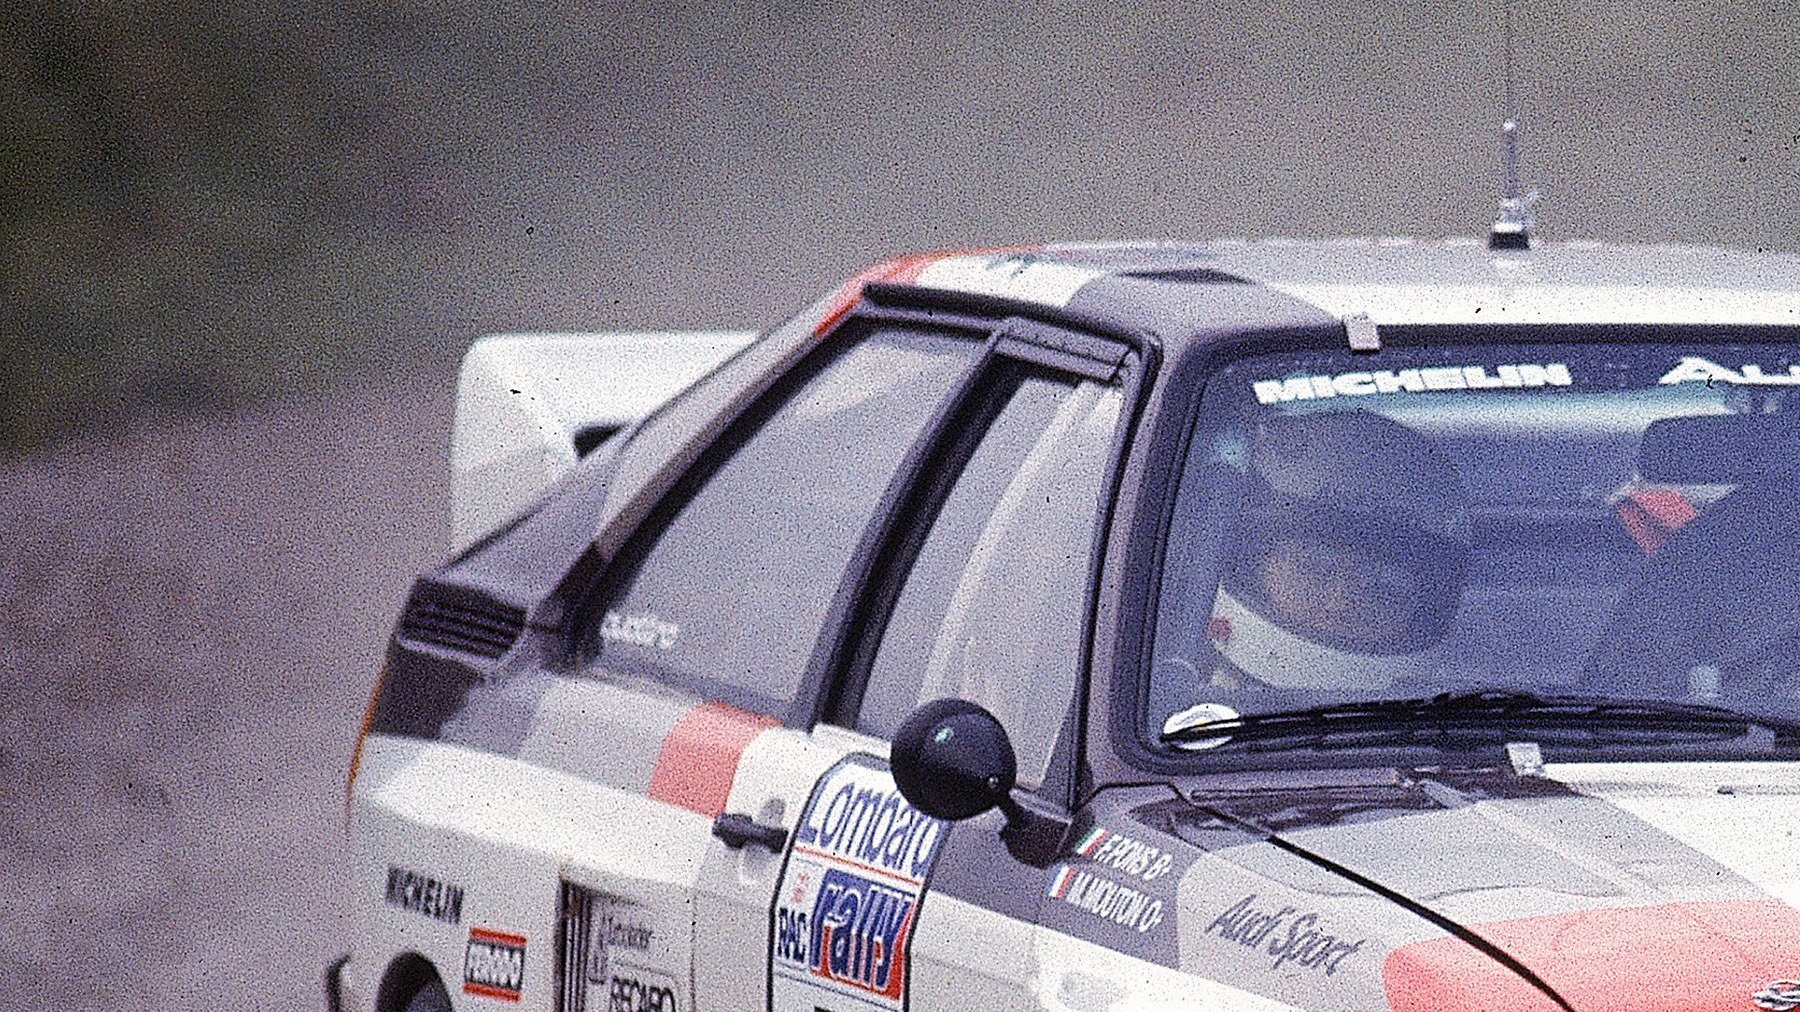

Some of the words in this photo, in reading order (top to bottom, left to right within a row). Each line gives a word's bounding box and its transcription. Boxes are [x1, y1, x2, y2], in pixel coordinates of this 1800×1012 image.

[1254, 363, 1572, 402] MICHELIN
[777, 906, 807, 964] RAC
[811, 884, 914, 991] rally
[1204, 894, 1294, 949] Audi
[1268, 913, 1366, 977] Sport
